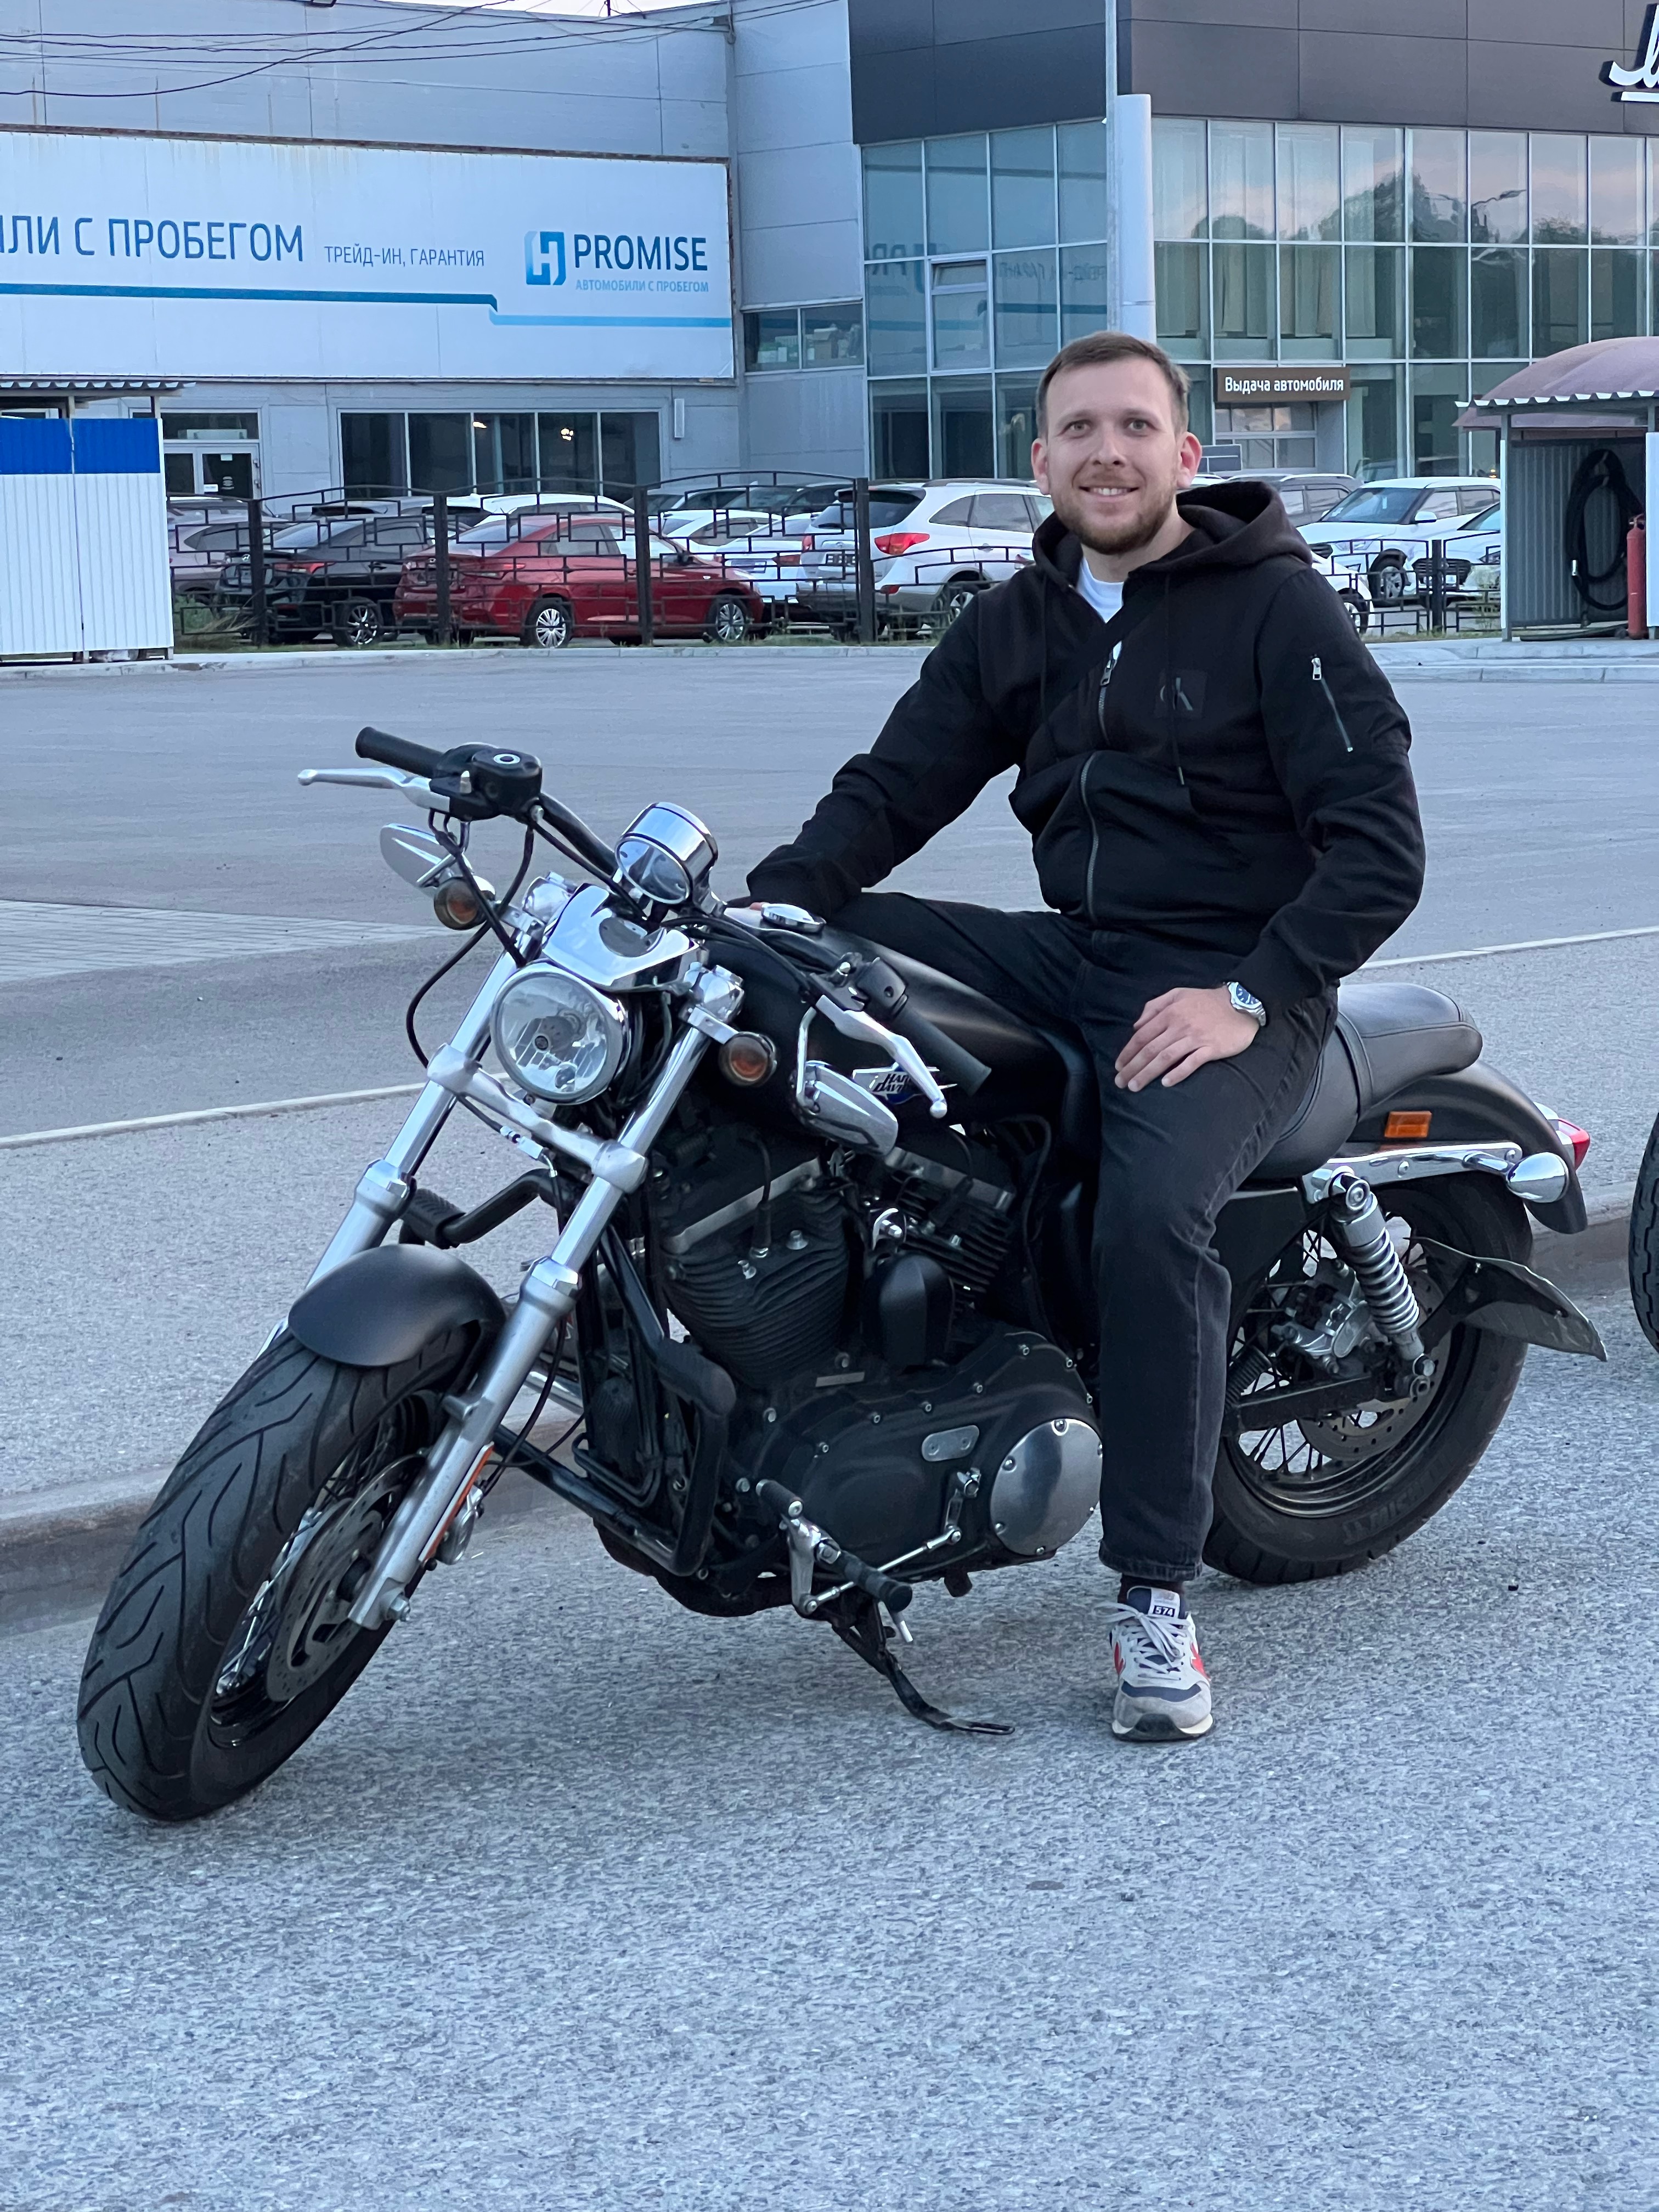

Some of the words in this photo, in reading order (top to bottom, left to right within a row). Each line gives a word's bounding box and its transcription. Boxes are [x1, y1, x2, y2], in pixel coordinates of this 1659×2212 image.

[75, 217, 95, 256] С
[109, 218, 303, 262] ПРОБЕГОМ
[324, 243, 405, 267] ТРЕЙД-ИН,
[410, 248, 484, 267] ГАРАНТИЯ
[574, 234, 708, 272] PROMISE
[576, 279, 646, 291] АВТОМОБИЛИ
[648, 280, 654, 292] С
[656, 280, 709, 292] ПРОБЕГОМ
[1225, 376, 1271, 394] Выдача
[1274, 376, 1344, 391] автомобиля
[1154, 1606, 1173, 1616] 574
